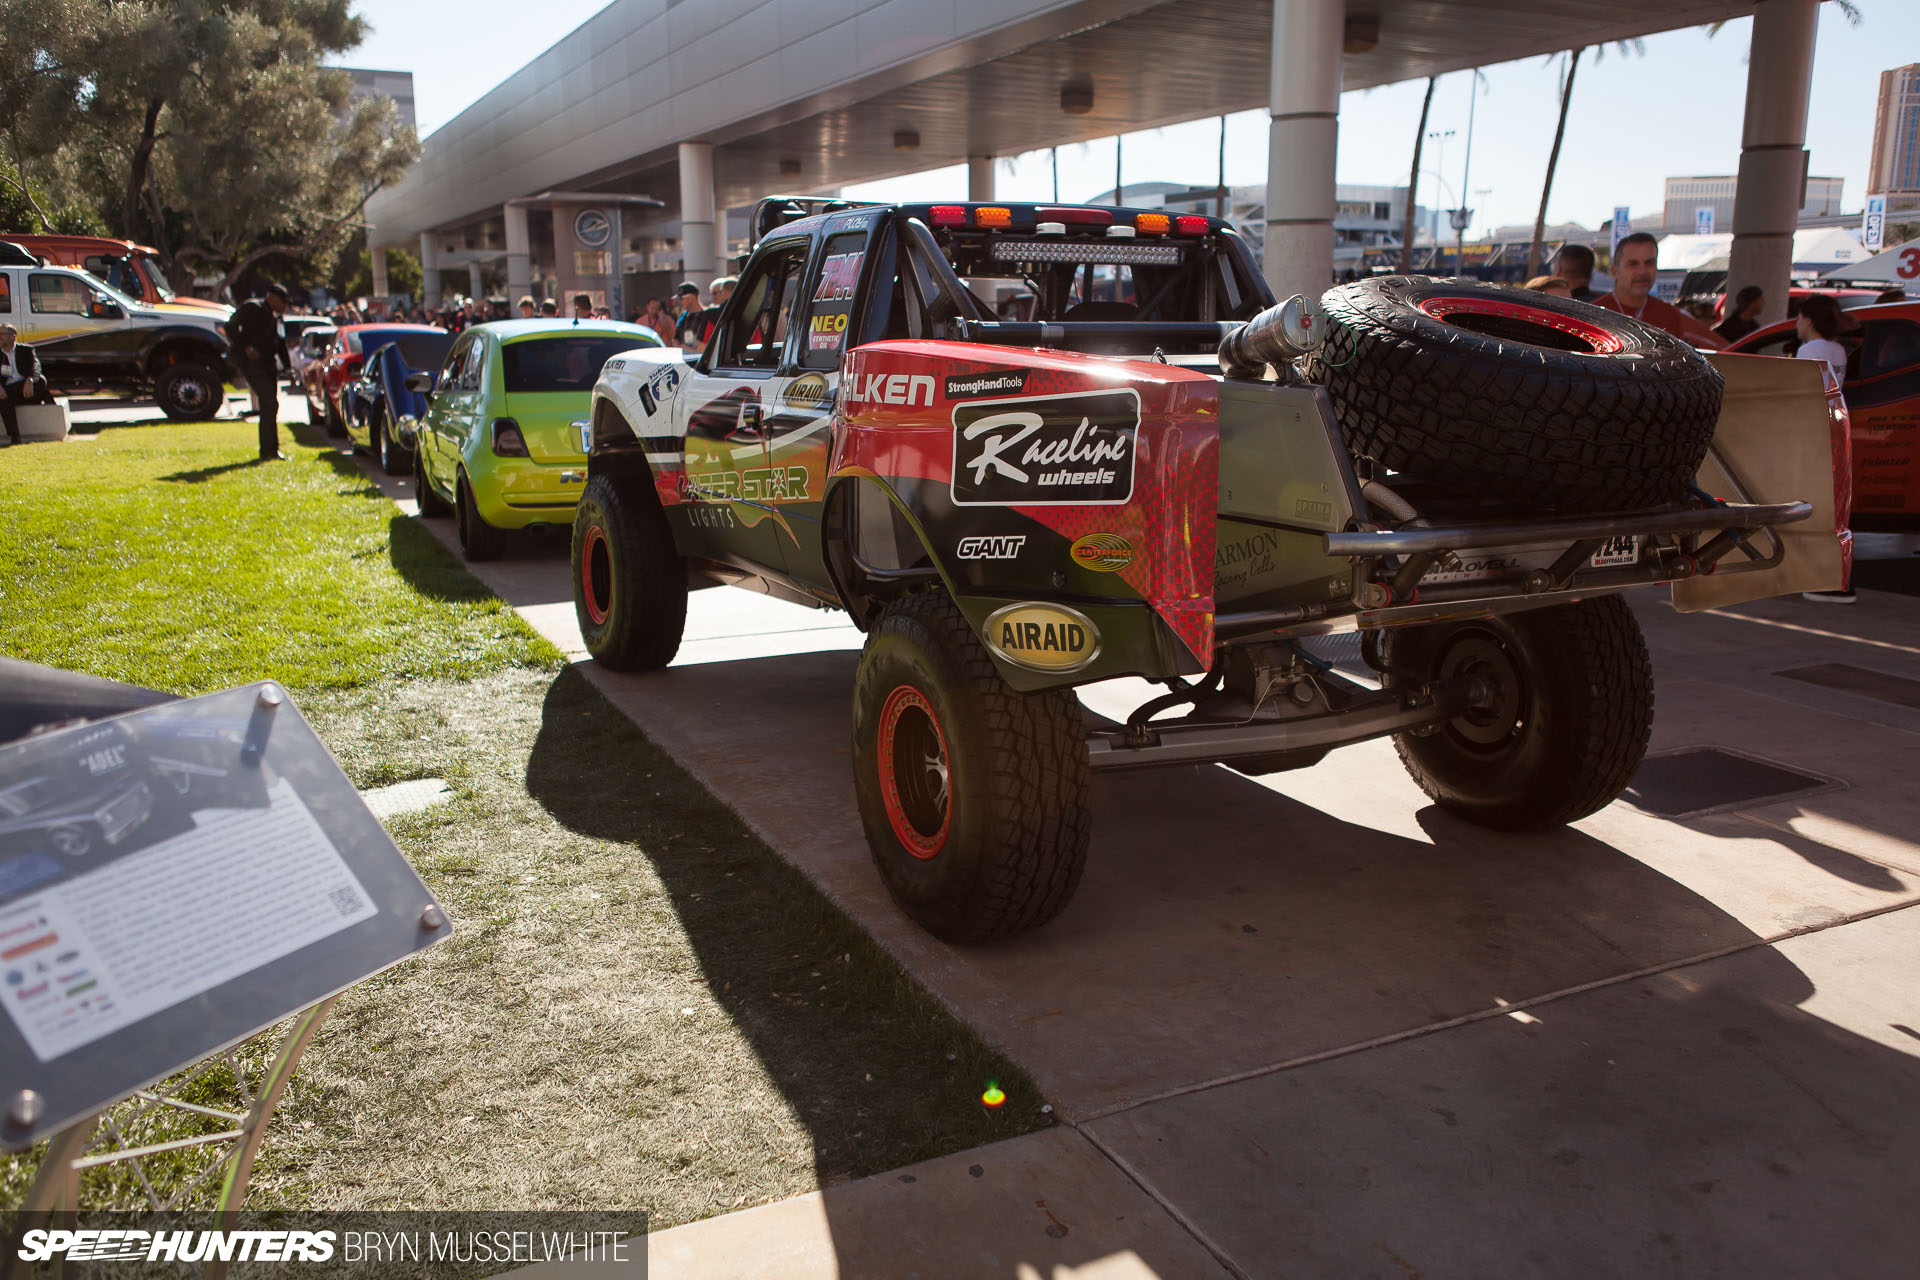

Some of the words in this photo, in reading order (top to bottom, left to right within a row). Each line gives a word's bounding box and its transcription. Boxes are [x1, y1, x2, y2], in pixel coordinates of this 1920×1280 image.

[811, 313, 849, 333] NEO
[790, 383, 824, 403] AIRAID
[948, 376, 1023, 393] StrongHandTools
[963, 412, 1126, 485] Raceline
[1038, 468, 1116, 486] wheels
[687, 507, 735, 529] LIGHTS
[957, 535, 1026, 559] GIANT
[1075, 547, 1132, 558] CENTERFORCE
[1215, 529, 1279, 568] ARMON
[1002, 622, 1085, 653] AIRAID
